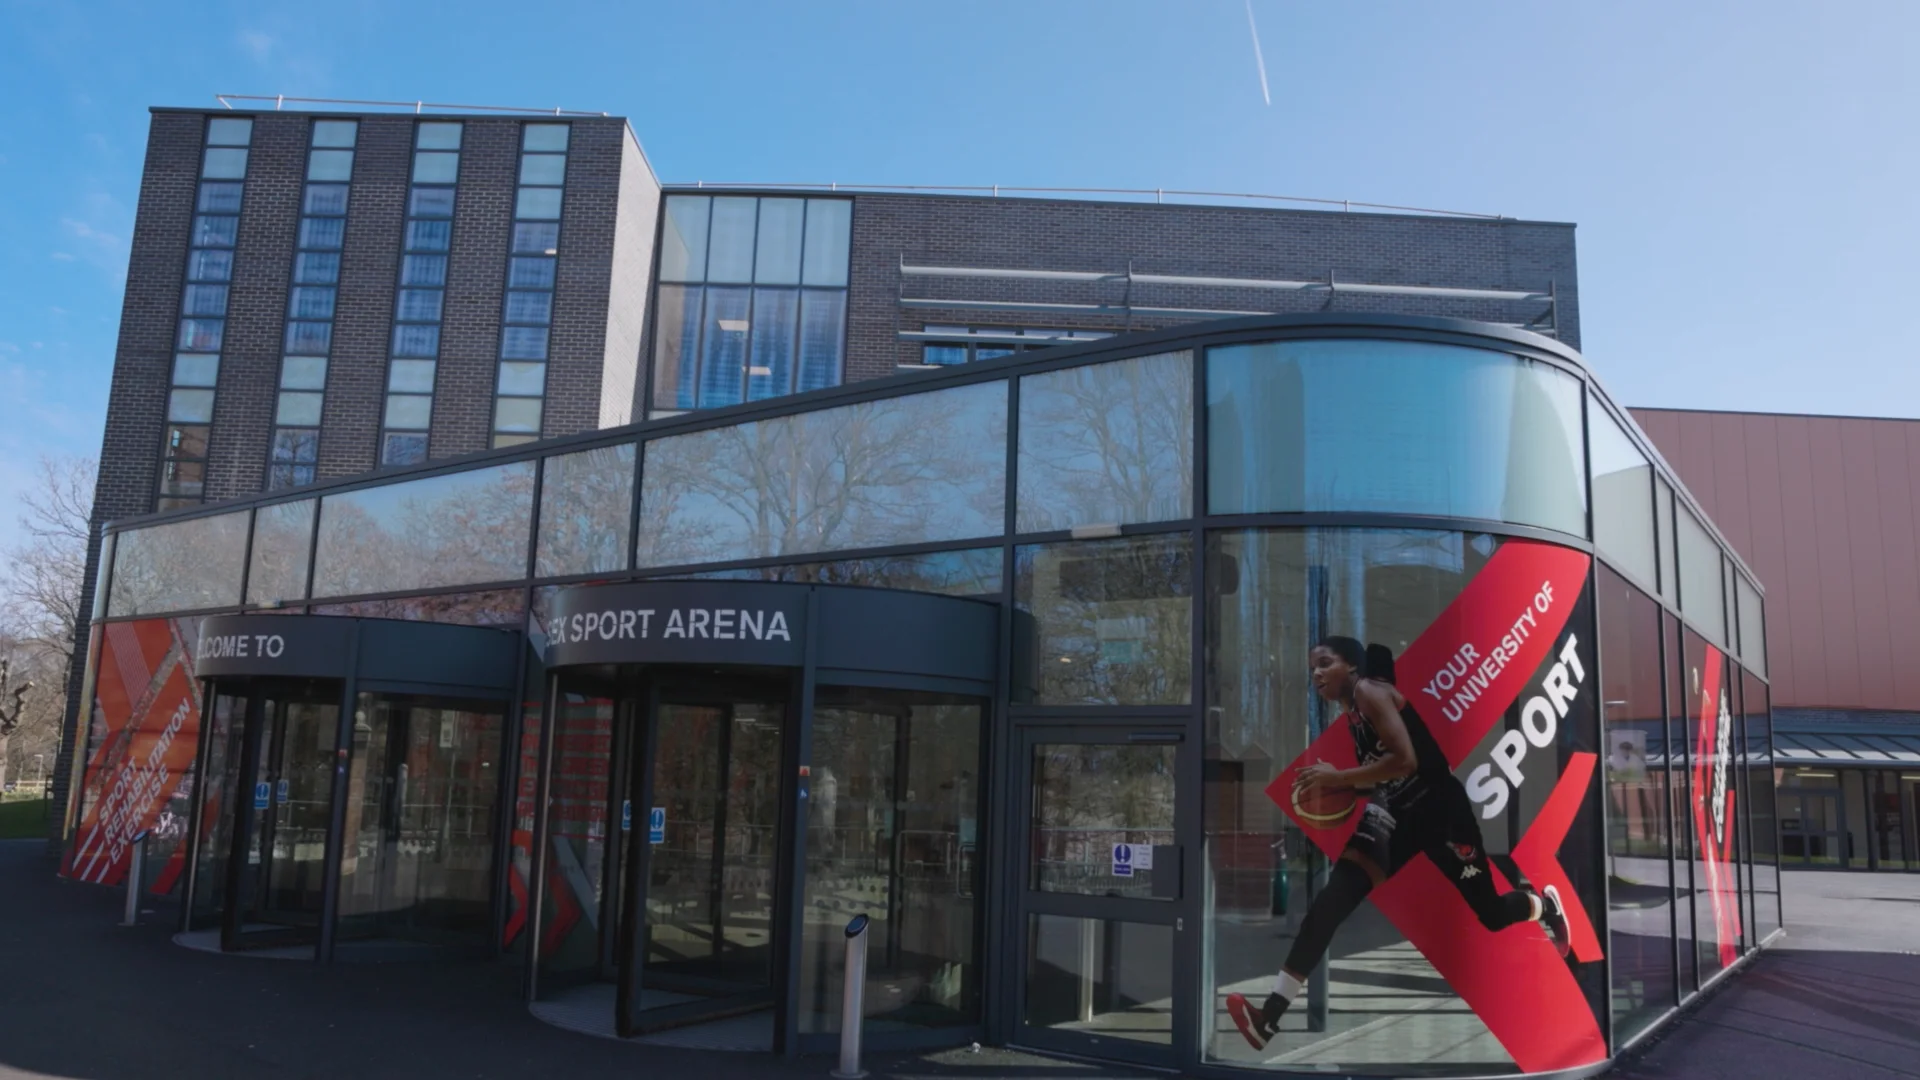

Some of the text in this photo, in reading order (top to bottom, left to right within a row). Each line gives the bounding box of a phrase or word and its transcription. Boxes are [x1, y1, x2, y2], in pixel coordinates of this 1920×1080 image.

[255, 634, 285, 658] TO
[570, 609, 655, 643] SPORT
[663, 608, 791, 642] ARENA
[1442, 580, 1554, 723] UNIVERSITY OF
[1422, 643, 1480, 700] YOUR
[1465, 633, 1585, 820] SPORT
[100, 756, 137, 826] SPORT
[104, 697, 191, 845] REHABILITATION
[110, 763, 169, 865] EXERCISE
